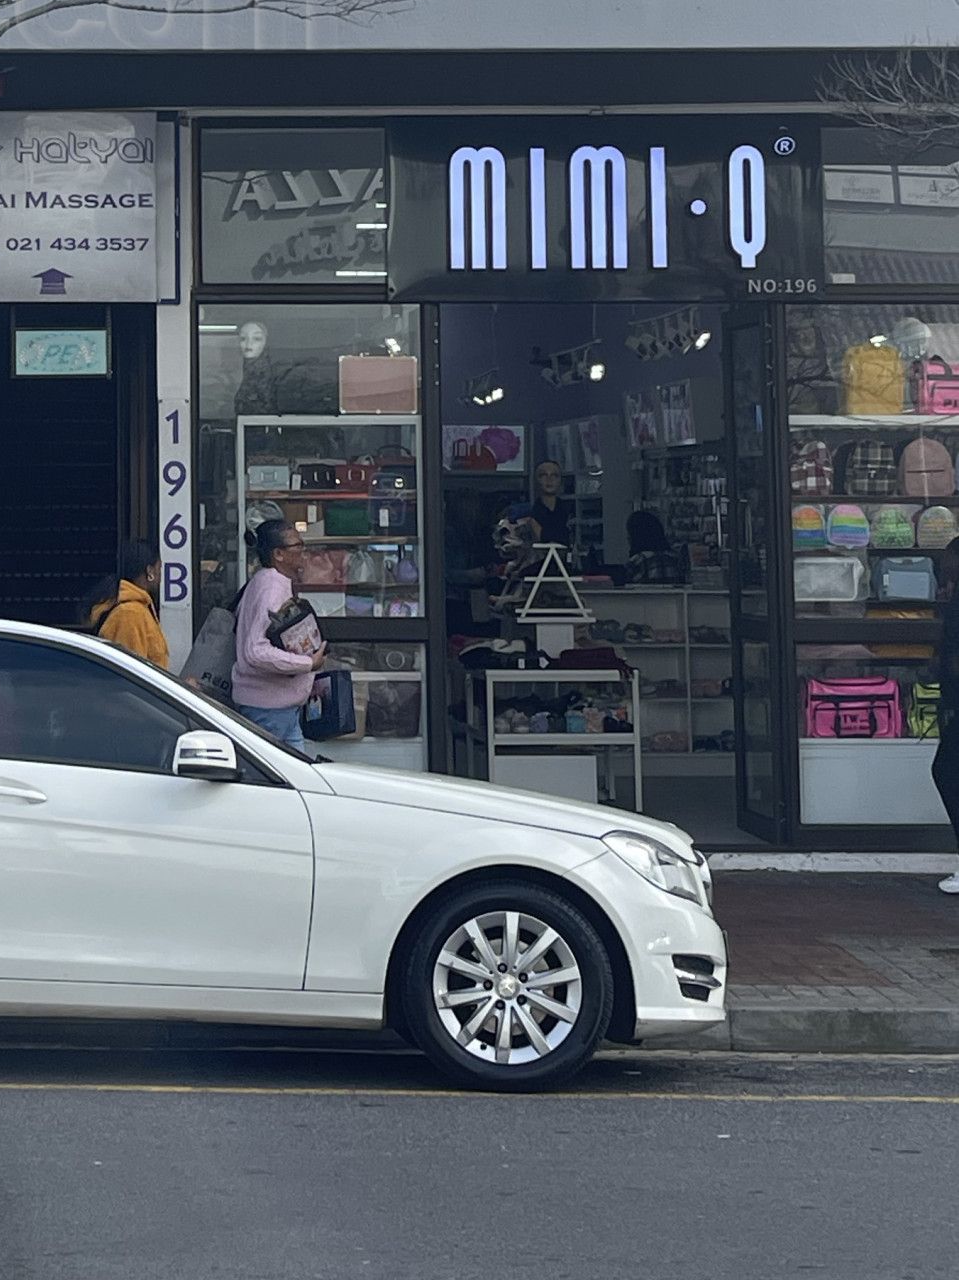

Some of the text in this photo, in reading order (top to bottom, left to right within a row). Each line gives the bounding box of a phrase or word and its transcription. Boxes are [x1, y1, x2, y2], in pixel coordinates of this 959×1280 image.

[6, 237, 41, 251] 021
[50, 237, 90, 251] 434
[95, 237, 150, 251] 3537
[748, 278, 817, 294] NO:196
